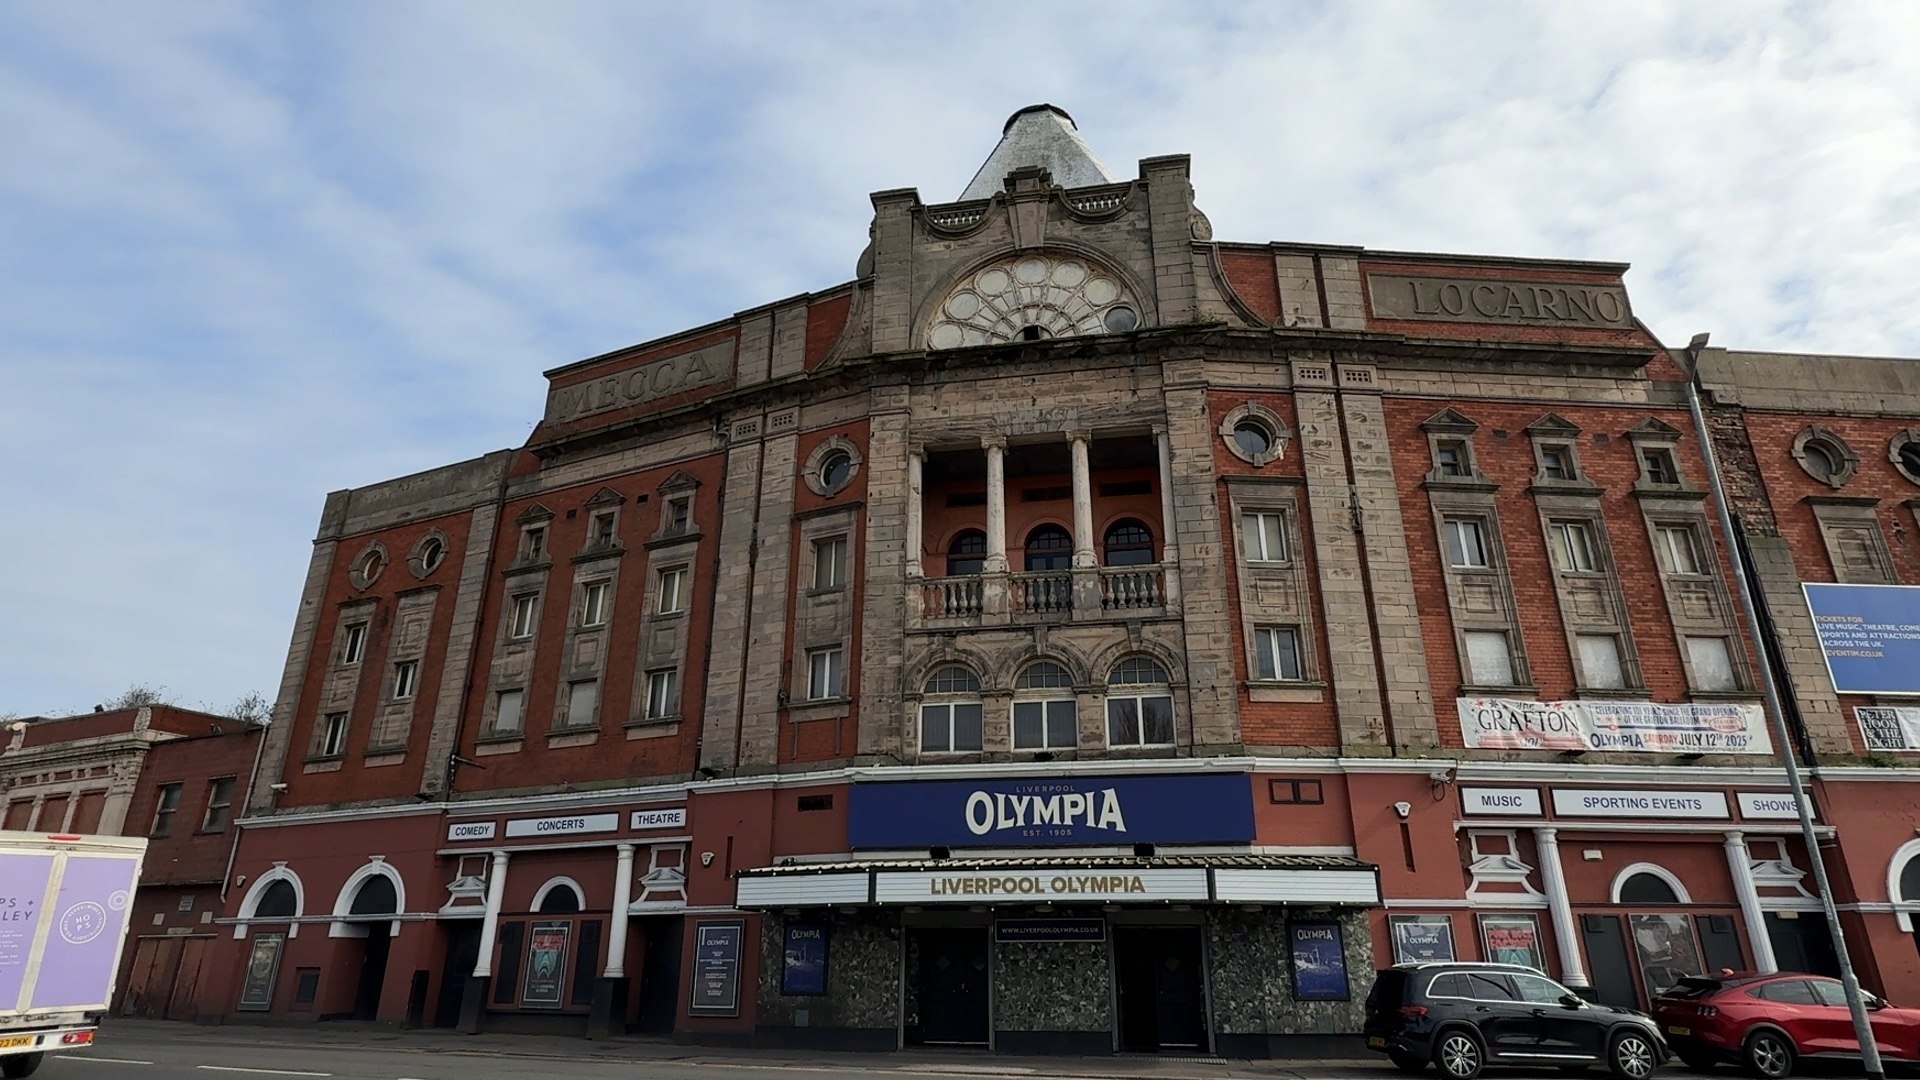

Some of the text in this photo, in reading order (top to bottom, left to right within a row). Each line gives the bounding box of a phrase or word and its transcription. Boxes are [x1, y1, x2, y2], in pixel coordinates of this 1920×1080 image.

[1409, 281, 1625, 323] LOCARNO
[550, 352, 716, 420] MECCA
[1825, 650, 1885, 658] EVENTIM.CO.UK
[1478, 709, 1579, 732] GRAFTON
[1858, 710, 1896, 719] PETER
[1862, 719, 1898, 729] HOOK
[1866, 729, 1902, 738] & THE
[1590, 733, 1747, 748] OLYMPIA SATURDAY JULY 12TH 2025
[1868, 739, 1904, 748] LIGHT
[1016, 785, 1075, 793] LIVERPOOL
[1481, 795, 1523, 807] MUSIC
[1583, 796, 1703, 810] SPORTING EVENTS
[1752, 799, 1799, 812] SHOWS
[965, 787, 1127, 836] OLYMPIA
[536, 818, 585, 831] CONCERTS
[637, 812, 681, 825] THEATRE
[455, 825, 490, 836] COMEDY
[1023, 829, 1072, 837] EST. 1905
[931, 876, 1146, 895] LIVERPOOL OLYMPIA
[791, 928, 820, 940] OLYMPIA
[1001, 926, 1100, 934] WWW.LIVERPOOLOLYMPIA.CO.UK
[1297, 928, 1334, 941] OLYMPIA
